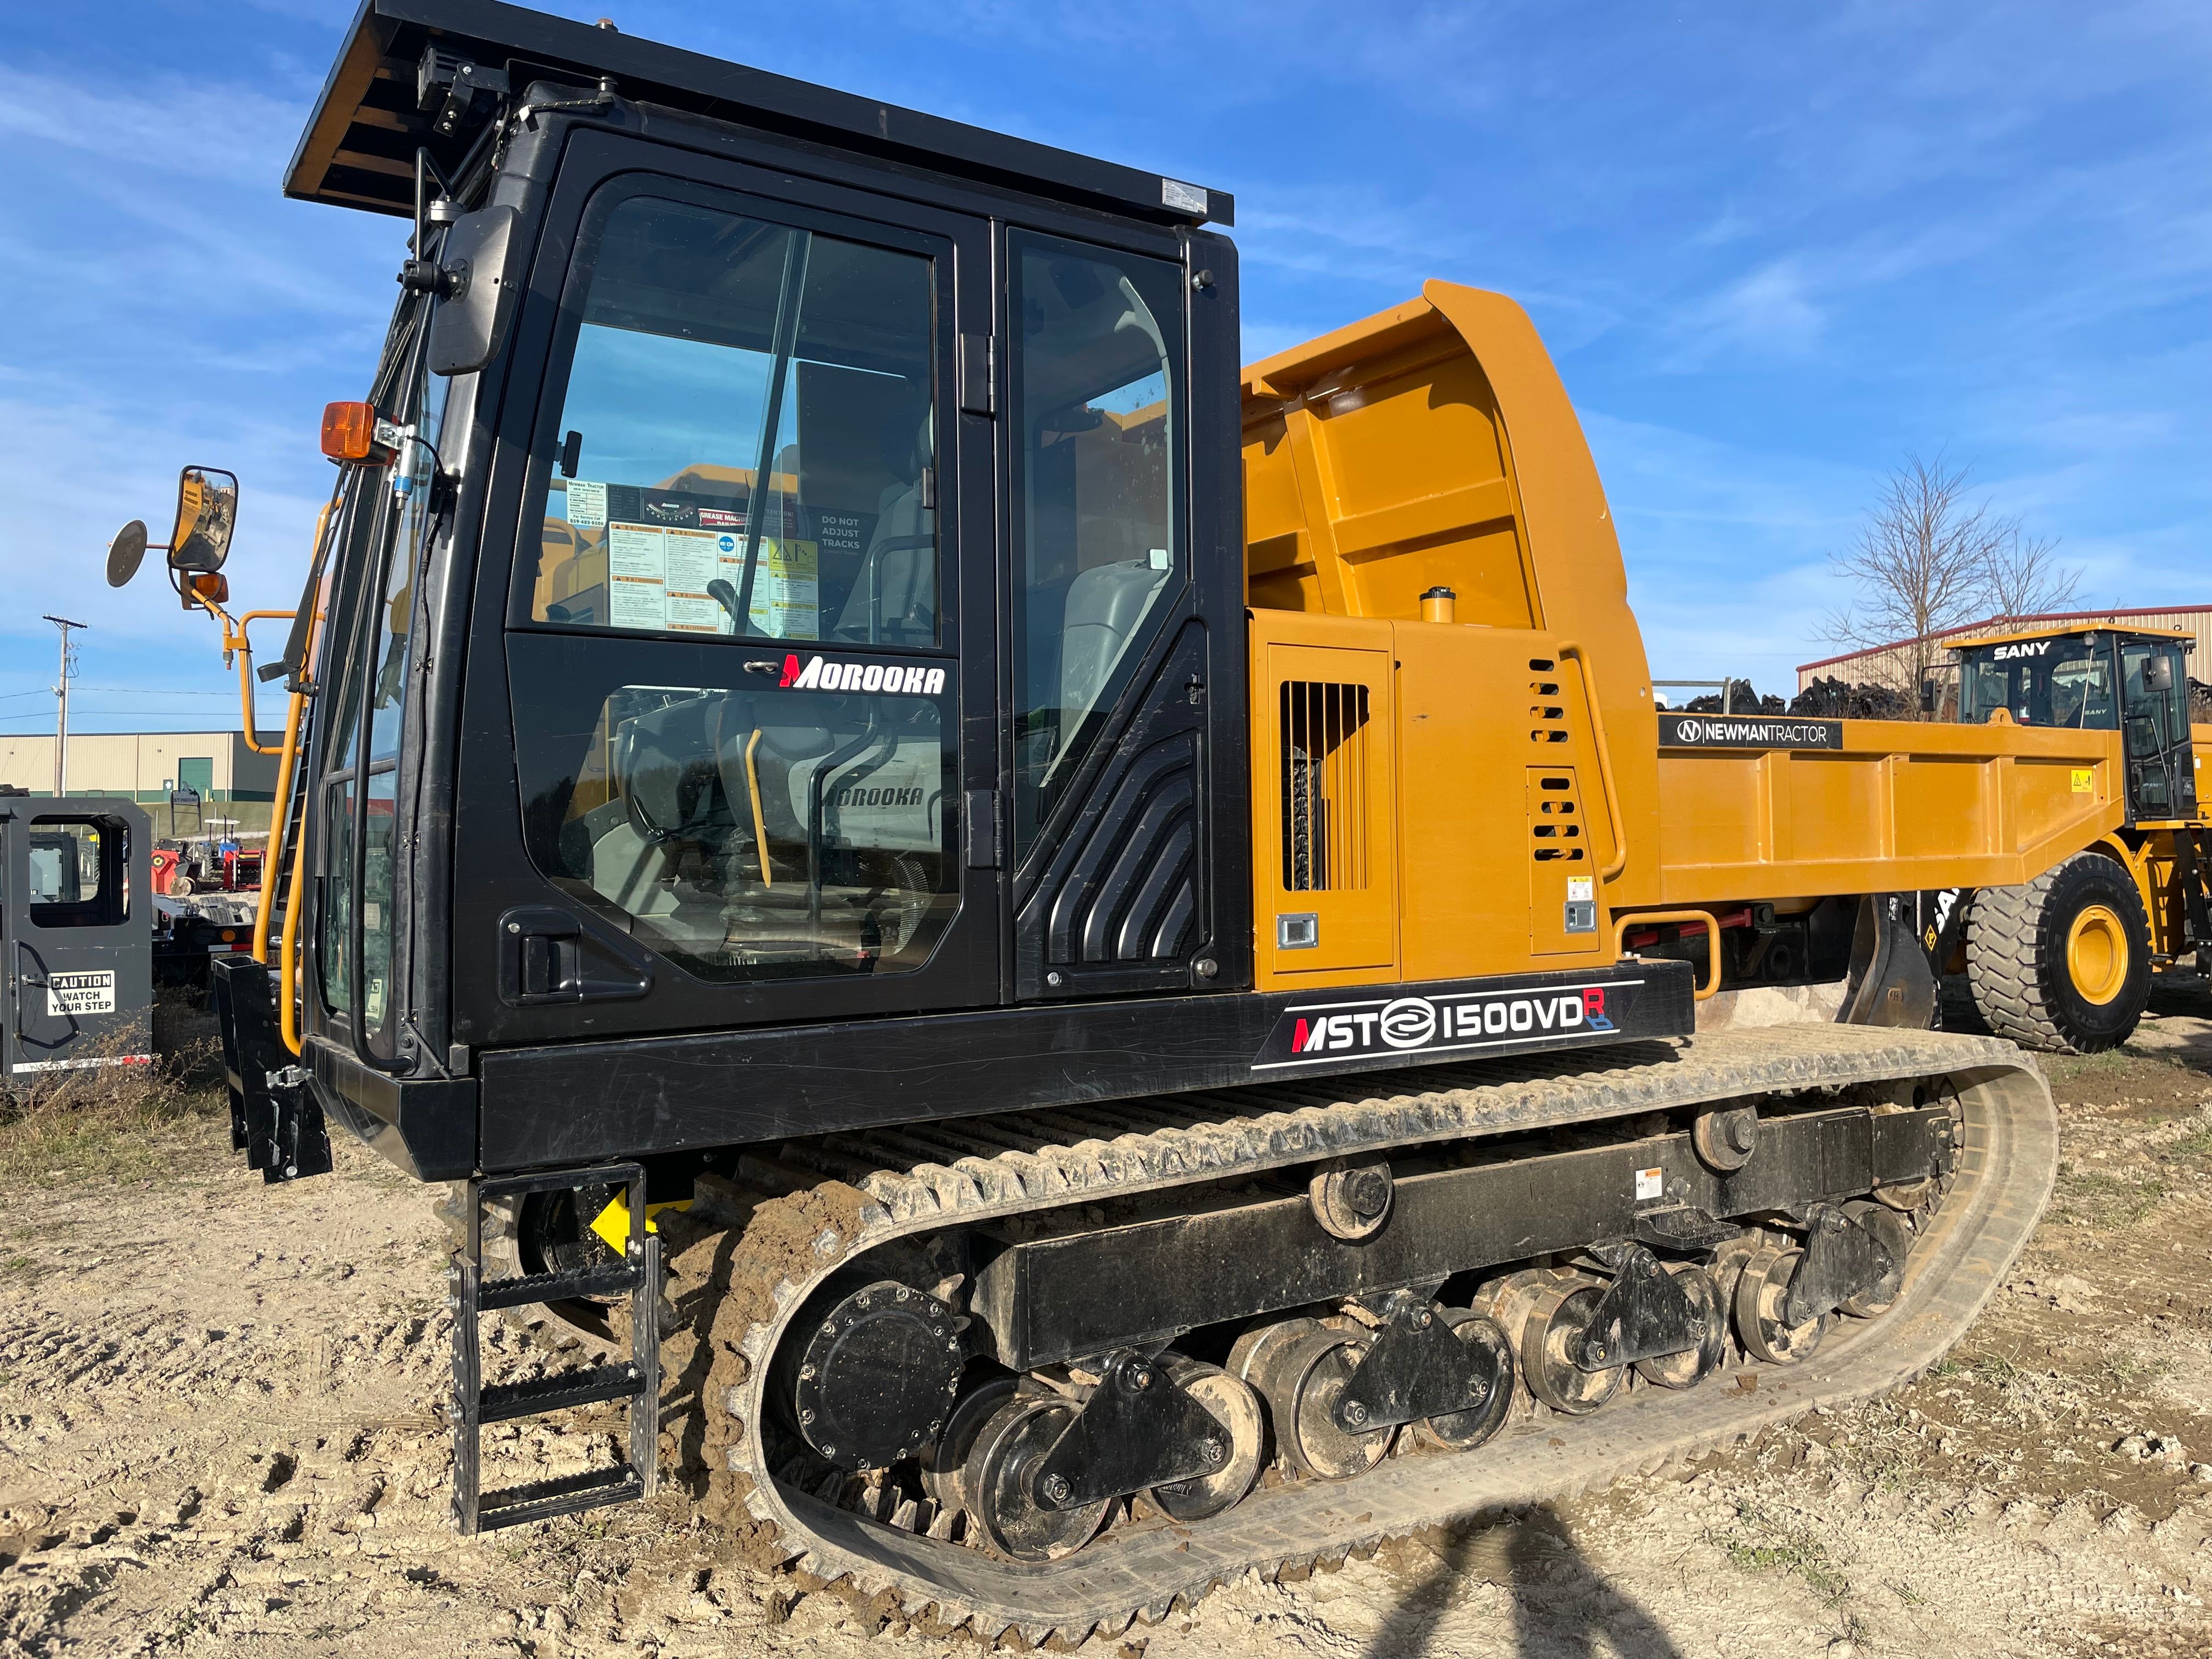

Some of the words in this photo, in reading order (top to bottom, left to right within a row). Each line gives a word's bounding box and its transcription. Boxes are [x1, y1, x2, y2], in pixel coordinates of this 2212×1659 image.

[700, 512, 723, 520] GREASE
[822, 516, 836, 524] DO
[839, 517, 859, 526] NOT
[822, 527, 859, 538] ADJUST
[822, 538, 860, 549] TRACKS
[1994, 641, 2051, 661] SANY
[779, 654, 945, 694] MOROOKA
[1706, 723, 1827, 742] NEWMANTRACTOR
[52, 975, 111, 988] CAUTION
[63, 991, 100, 1001] WATCH
[52, 1002, 82, 1012] YOUR
[85, 1001, 111, 1011] STEP
[1291, 1011, 1379, 1053] MST
